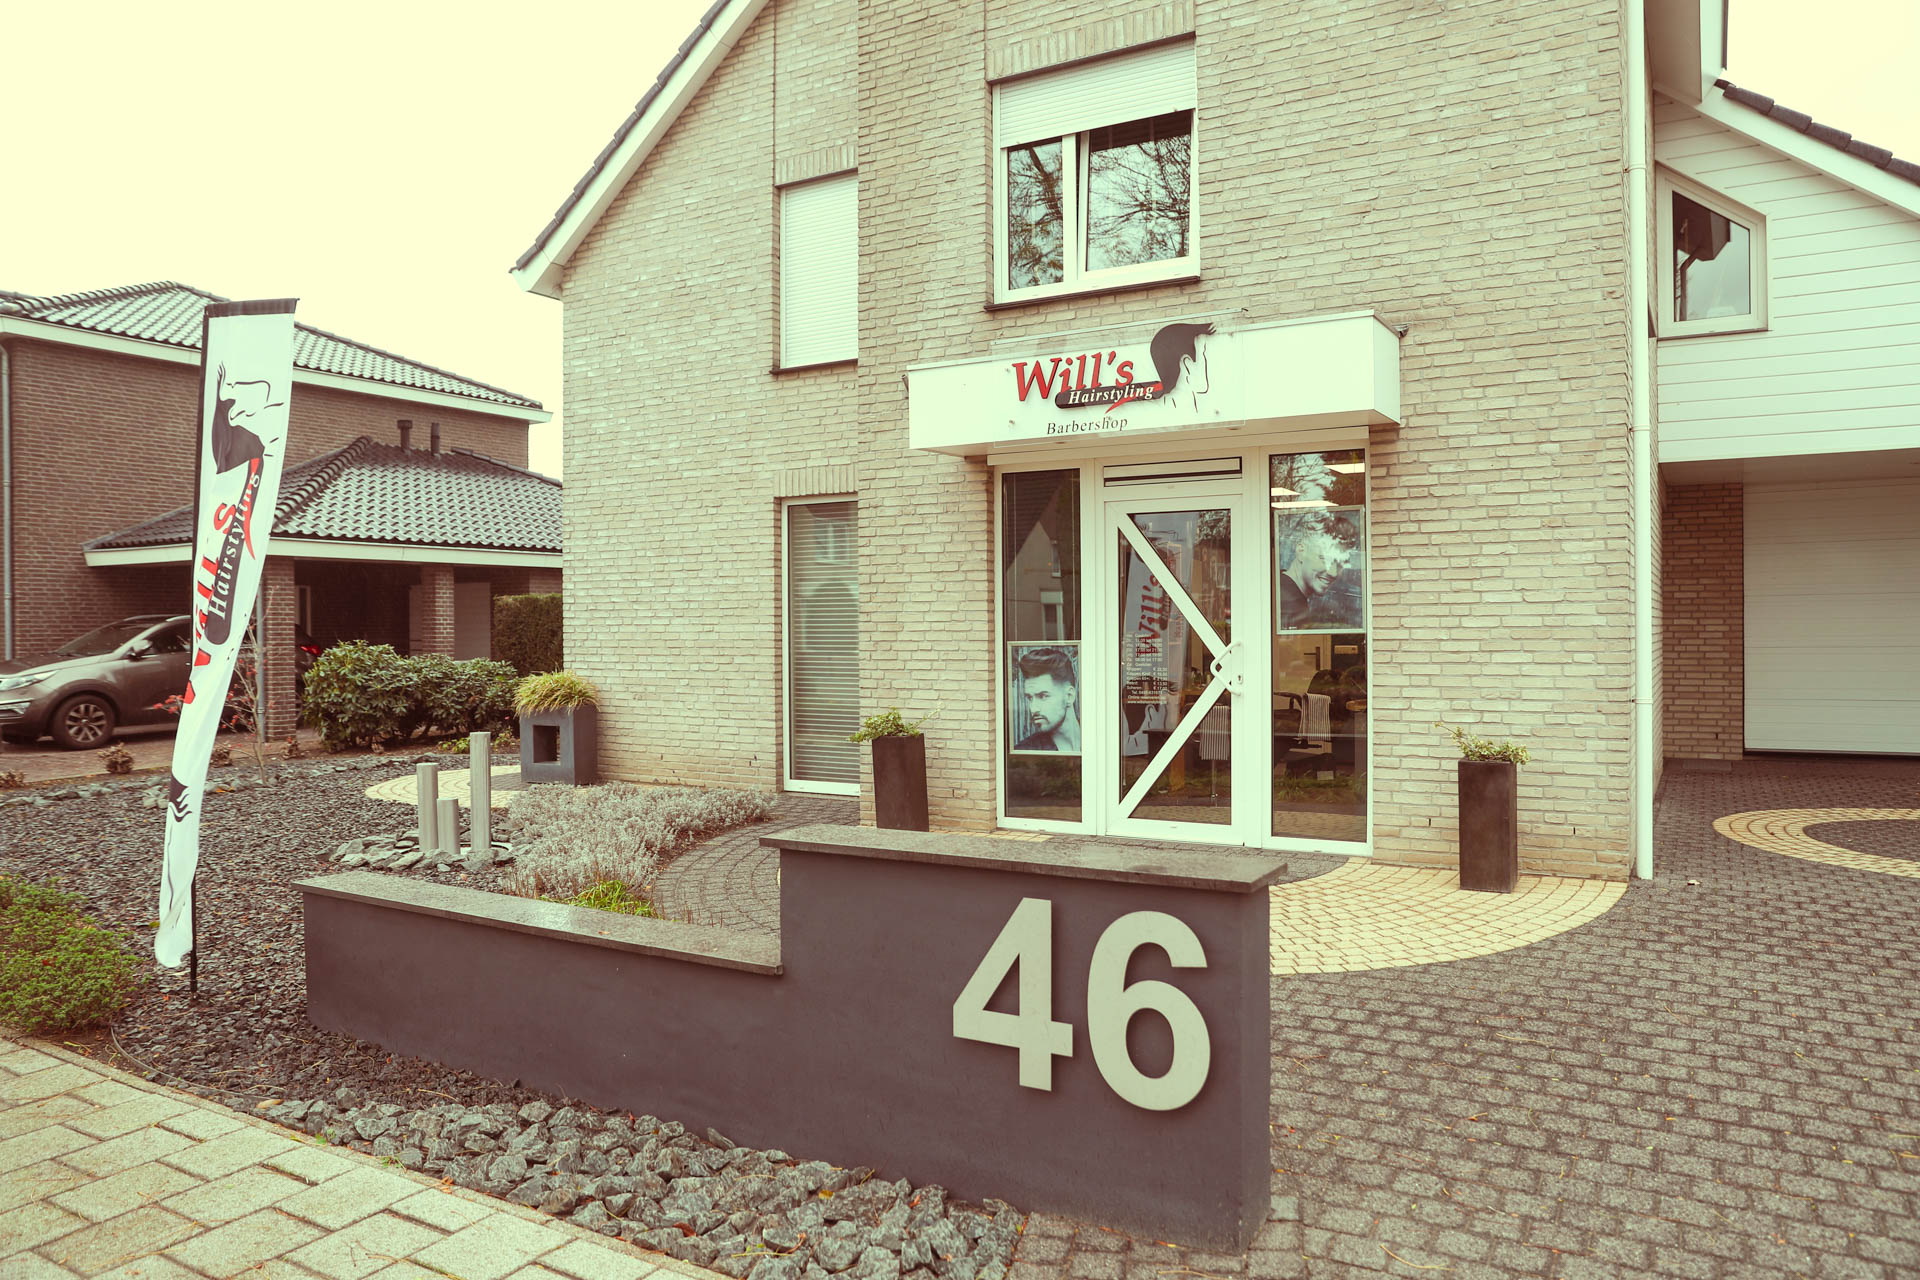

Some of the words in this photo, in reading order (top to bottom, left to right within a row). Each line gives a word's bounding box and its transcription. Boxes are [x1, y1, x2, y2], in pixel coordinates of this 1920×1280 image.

[1012, 350, 1134, 402] Will's
[1067, 384, 1155, 405] Hairstyling
[1046, 416, 1128, 436] Barbershop
[208, 472, 261, 620] Hairstyling
[953, 897, 1211, 1111] 46
